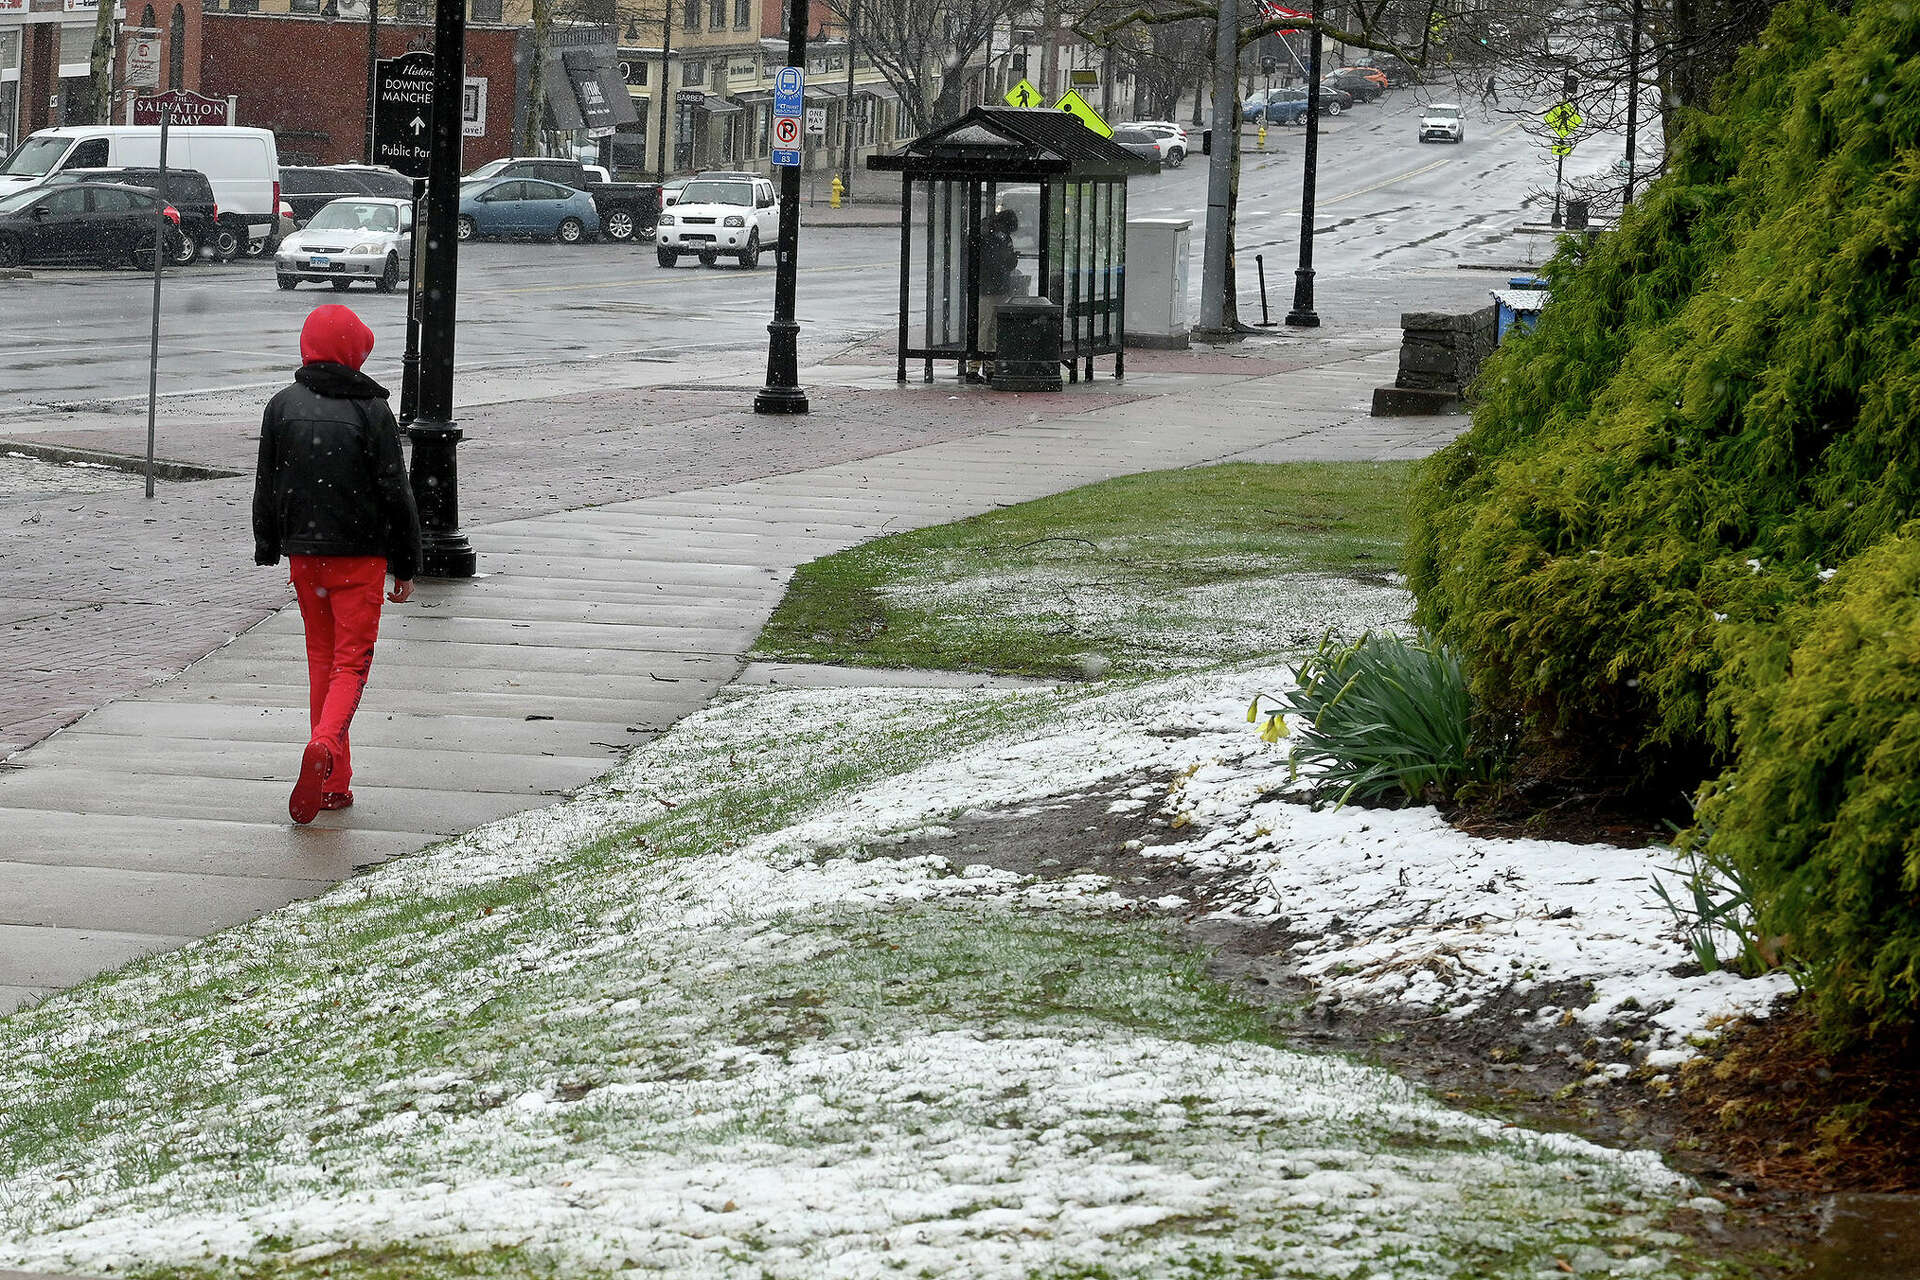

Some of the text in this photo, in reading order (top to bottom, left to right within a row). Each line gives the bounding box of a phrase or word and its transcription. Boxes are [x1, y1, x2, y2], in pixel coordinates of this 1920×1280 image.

[402, 64, 434, 77] Histori
[385, 79, 434, 92] DOWNTO
[382, 91, 434, 104] MANCHE
[676, 93, 704, 102] BARBER
[137, 100, 224, 115] SALVATION
[462, 126, 483, 135] ove!
[382, 144, 431, 158] Public Par
[781, 155, 790, 163] 83
